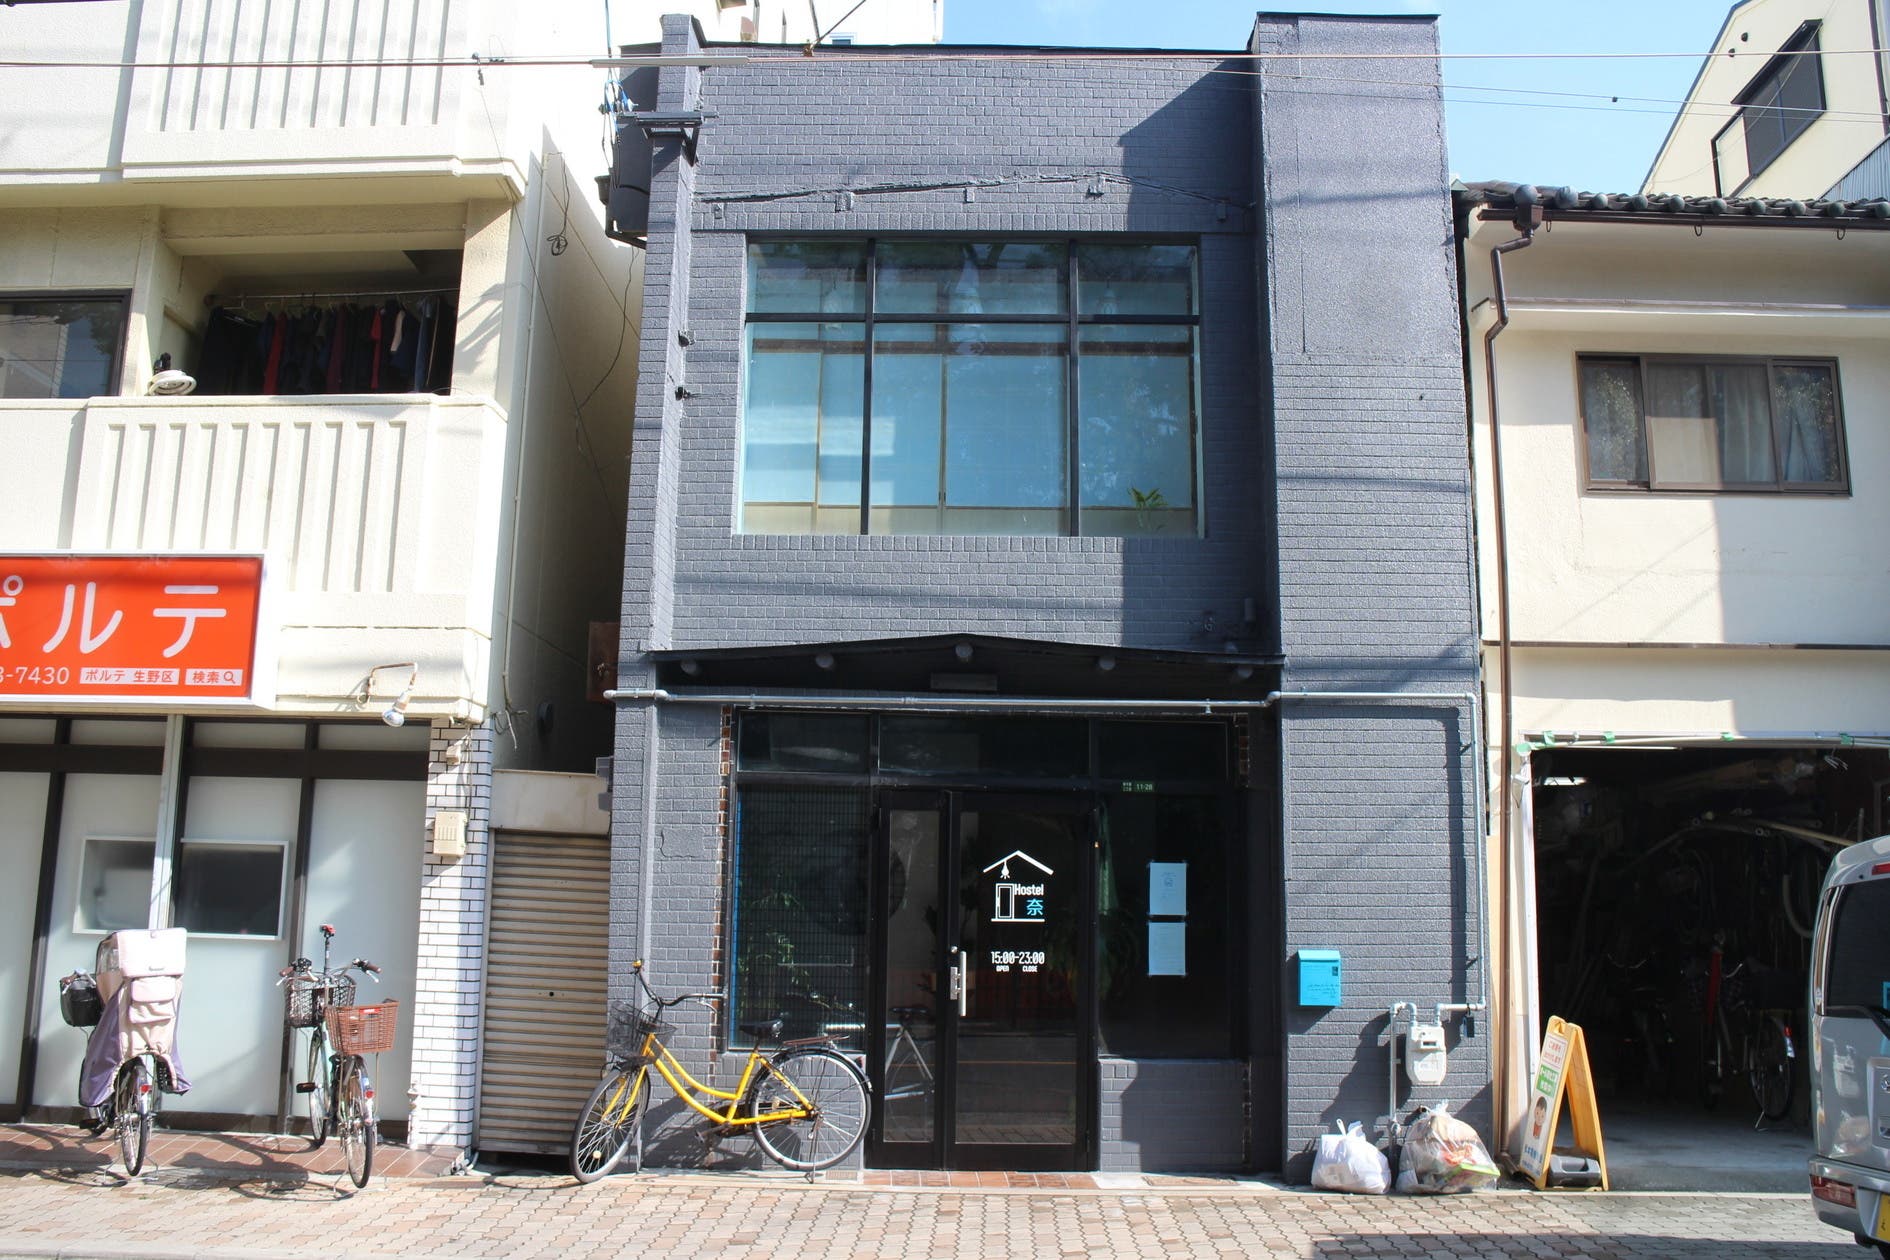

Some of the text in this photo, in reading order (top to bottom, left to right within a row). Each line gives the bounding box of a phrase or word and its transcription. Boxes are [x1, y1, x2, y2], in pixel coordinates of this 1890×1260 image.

[85, 670, 174, 683] ポルテ 生野区
[192, 670, 220, 684] 検索
[1014, 884, 1044, 896] Hostel
[1026, 898, 1044, 916] 奈
[991, 951, 1046, 965] 15:00-23:00
[996, 965, 1038, 973] OPEN CLOSE
